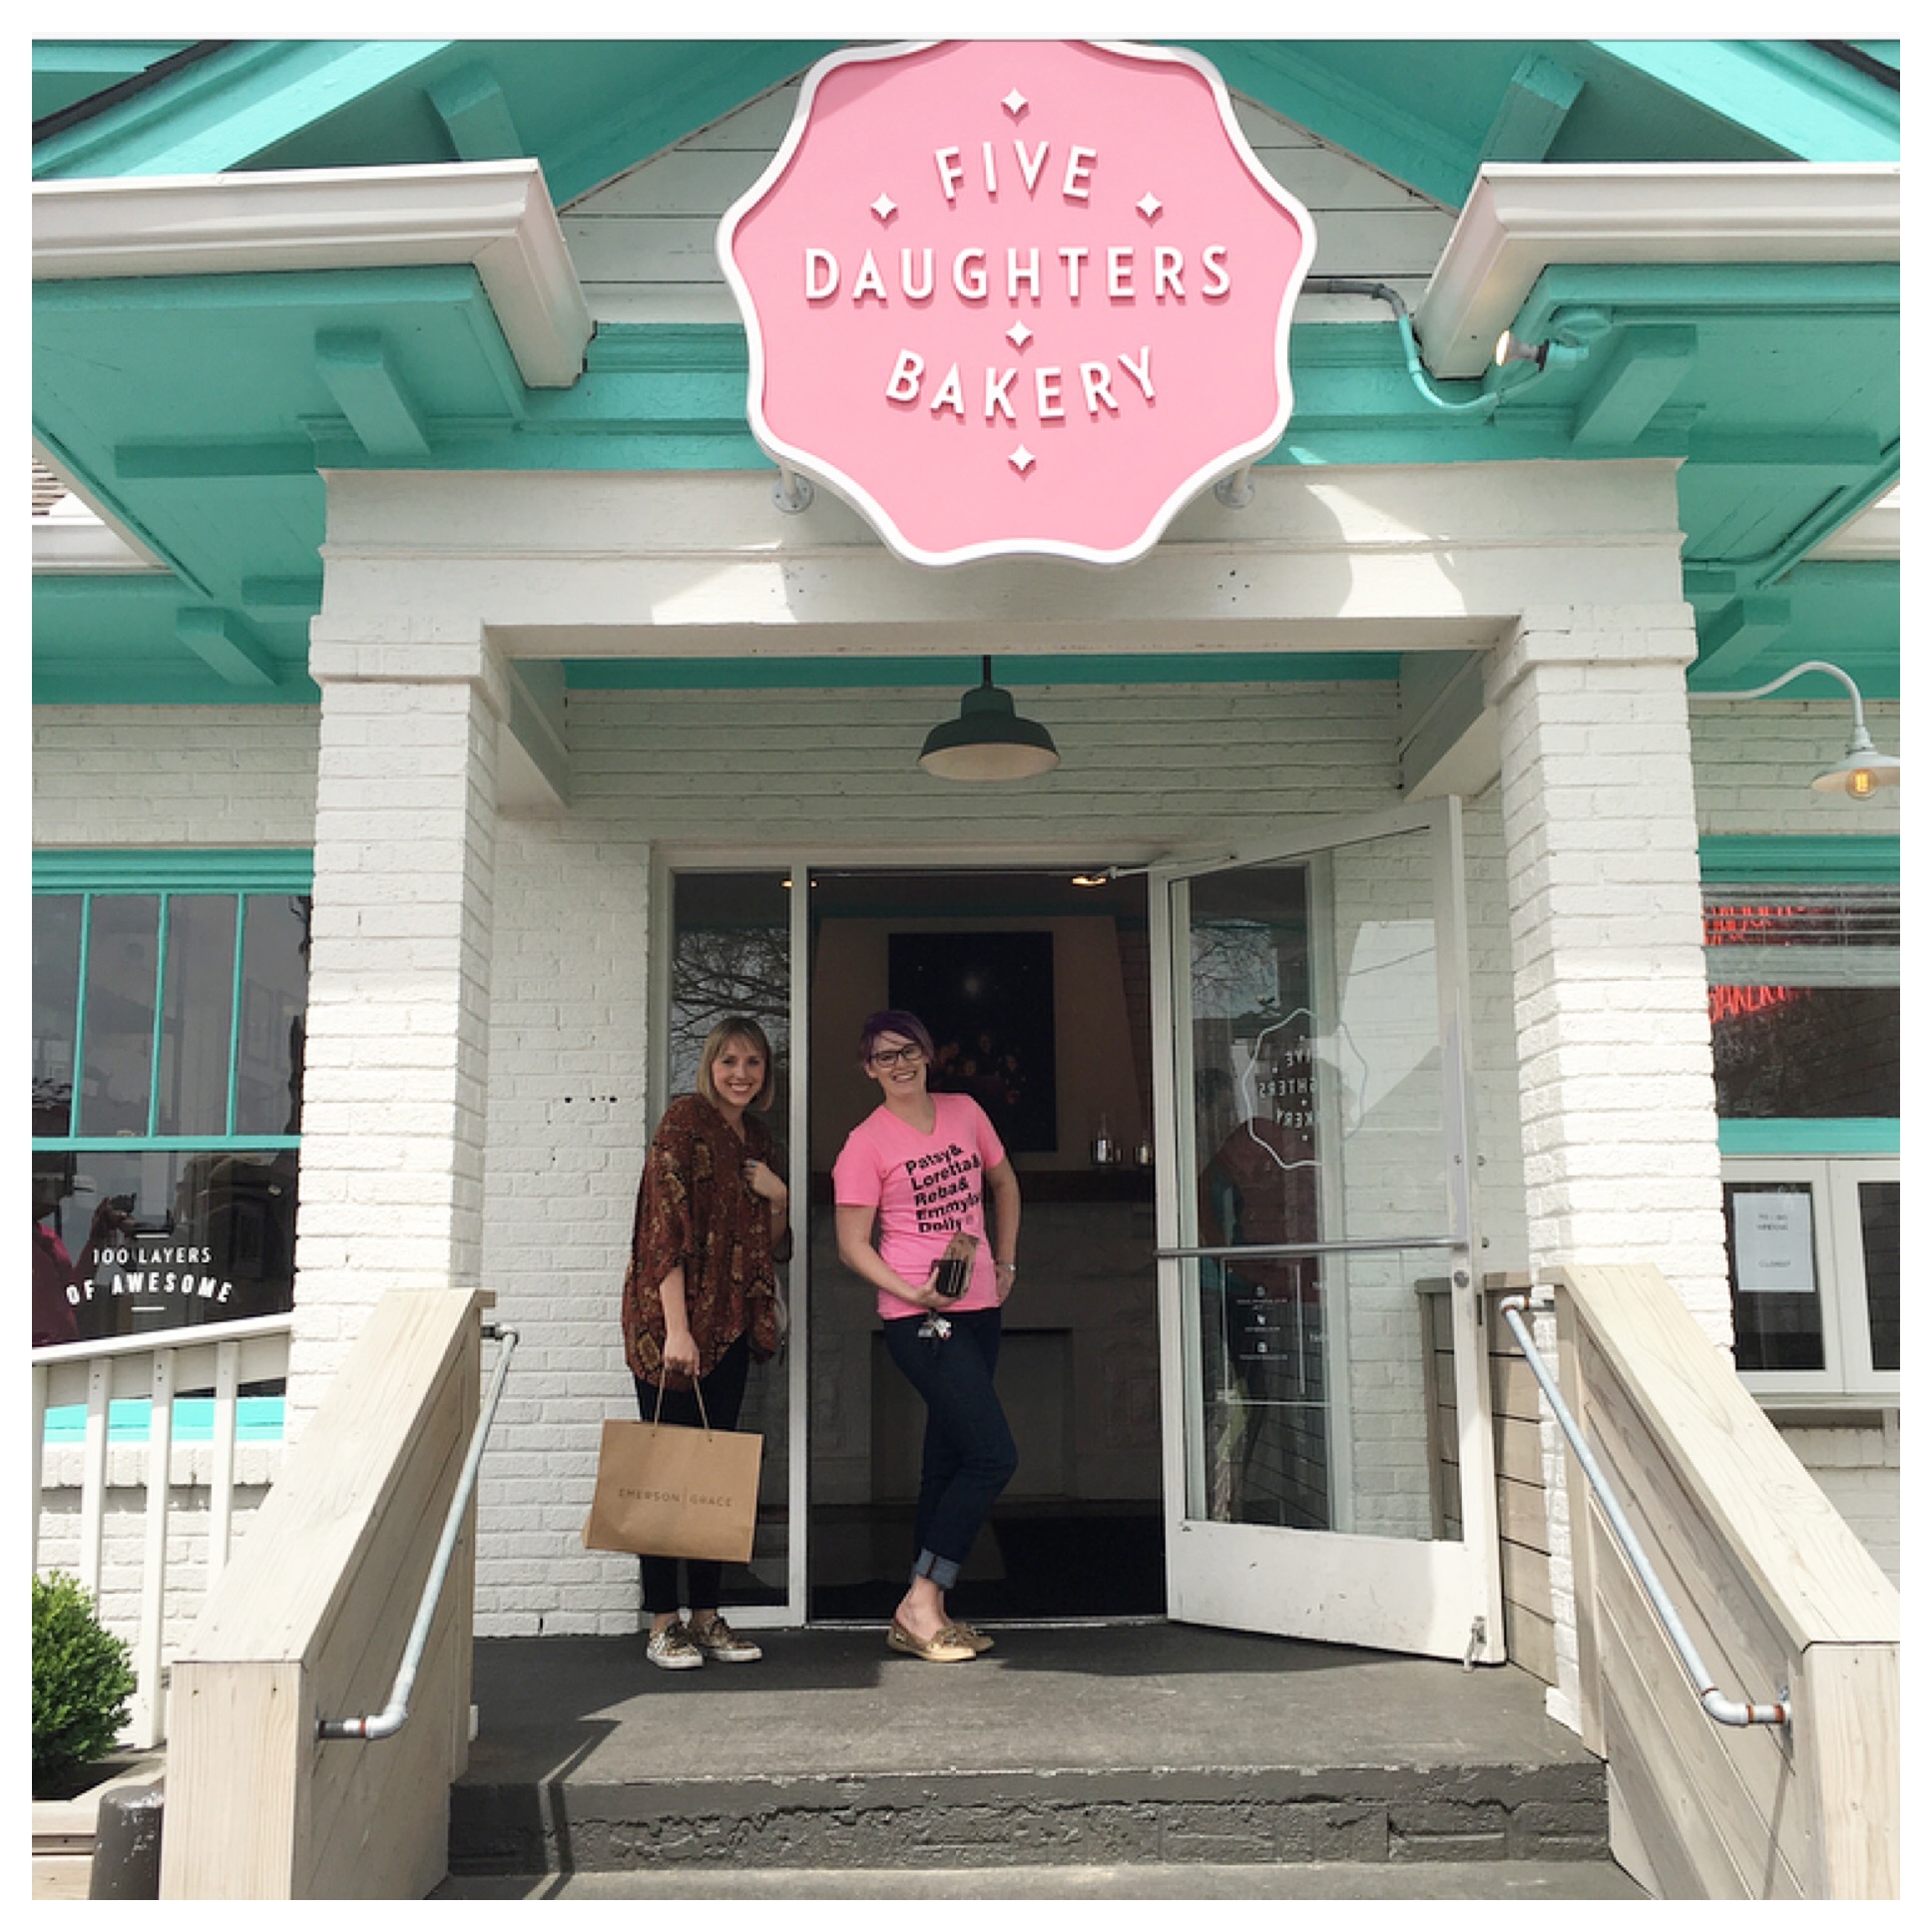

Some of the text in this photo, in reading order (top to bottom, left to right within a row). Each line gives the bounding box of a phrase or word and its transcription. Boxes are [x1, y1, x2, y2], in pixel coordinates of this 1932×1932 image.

[934, 140, 1099, 203] FIVE
[804, 245, 1231, 301] DAUGHTERS
[885, 346, 1157, 421] BAKERY
[93, 1247, 213, 1263] 100 LAYERS
[66, 1271, 233, 1306] OF AWESOME
